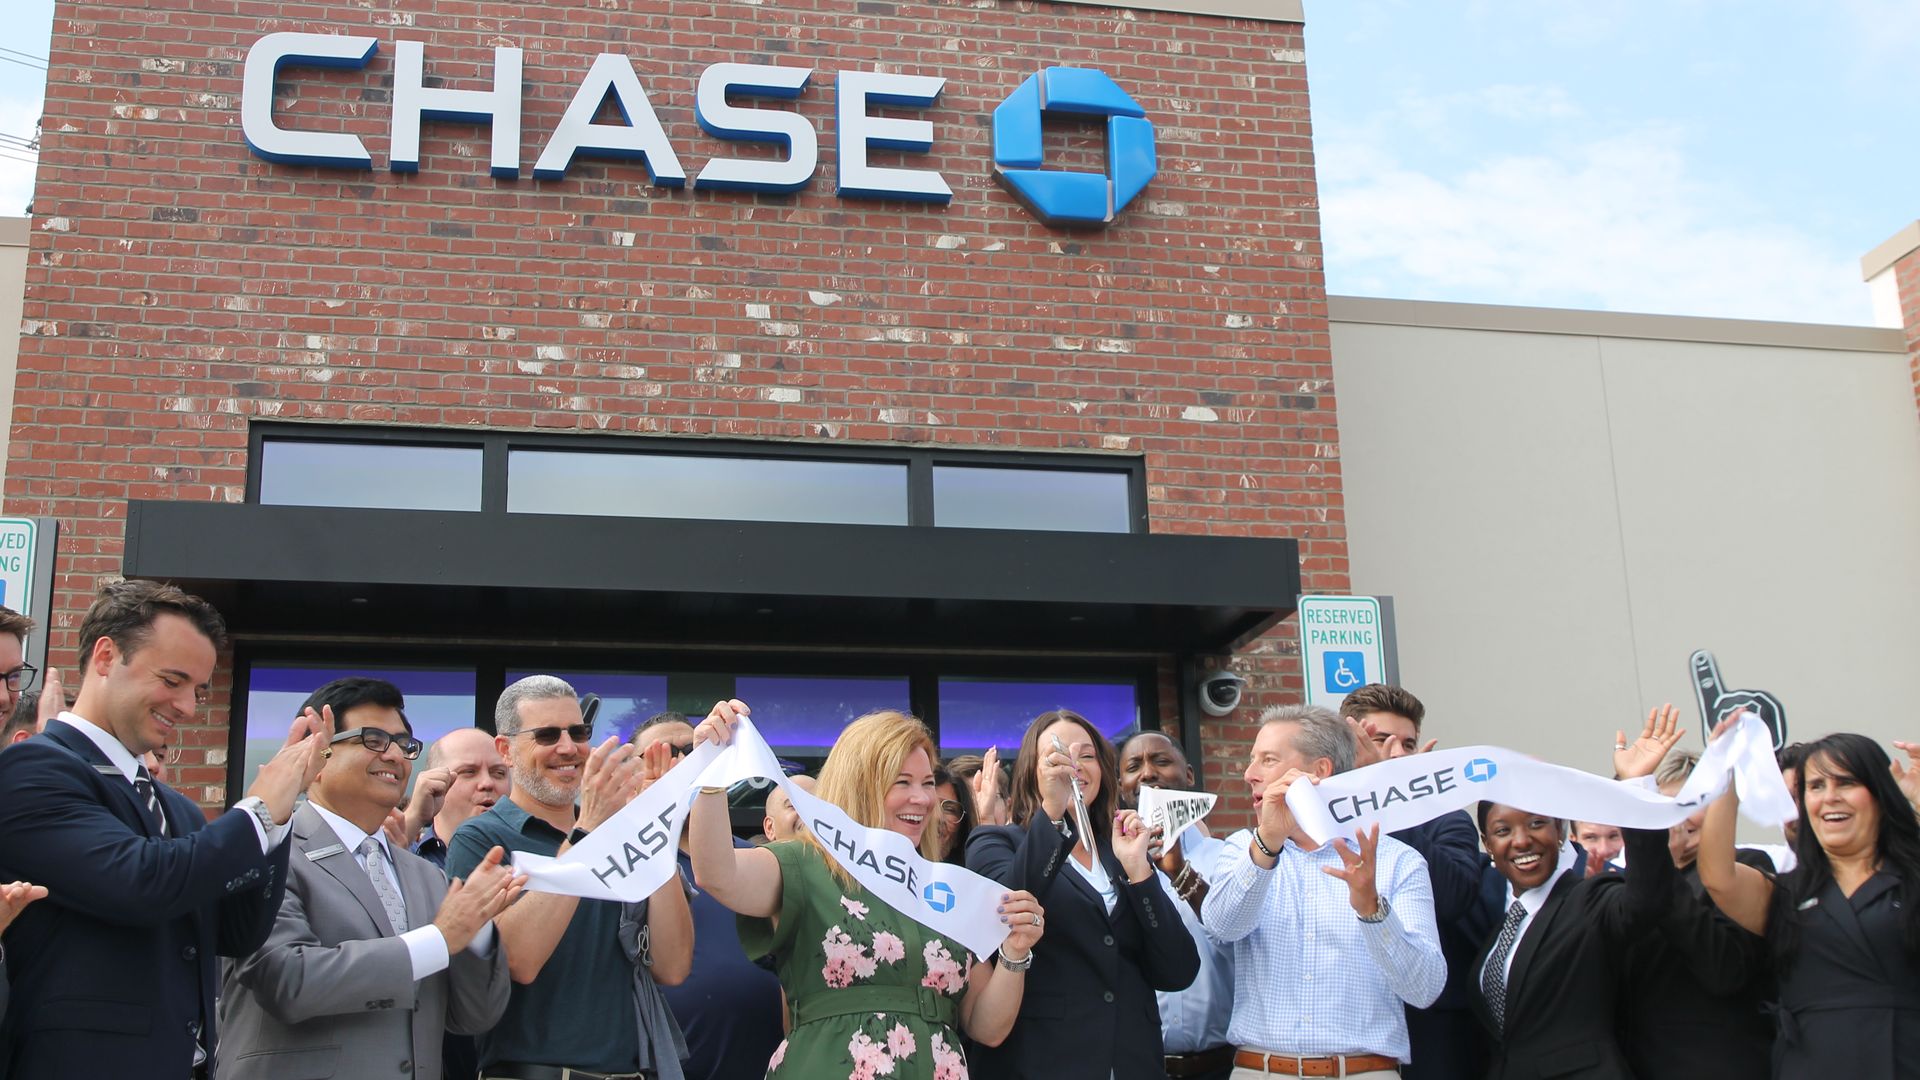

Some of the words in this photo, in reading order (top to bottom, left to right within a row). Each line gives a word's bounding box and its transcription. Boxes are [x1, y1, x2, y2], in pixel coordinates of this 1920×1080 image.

[242, 32, 953, 204] CHASE
[1307, 609, 1373, 624] RESERVED
[1311, 630, 1372, 645] PARKING
[1328, 767, 1458, 824] CHASE
[813, 818, 919, 900] CHASE
